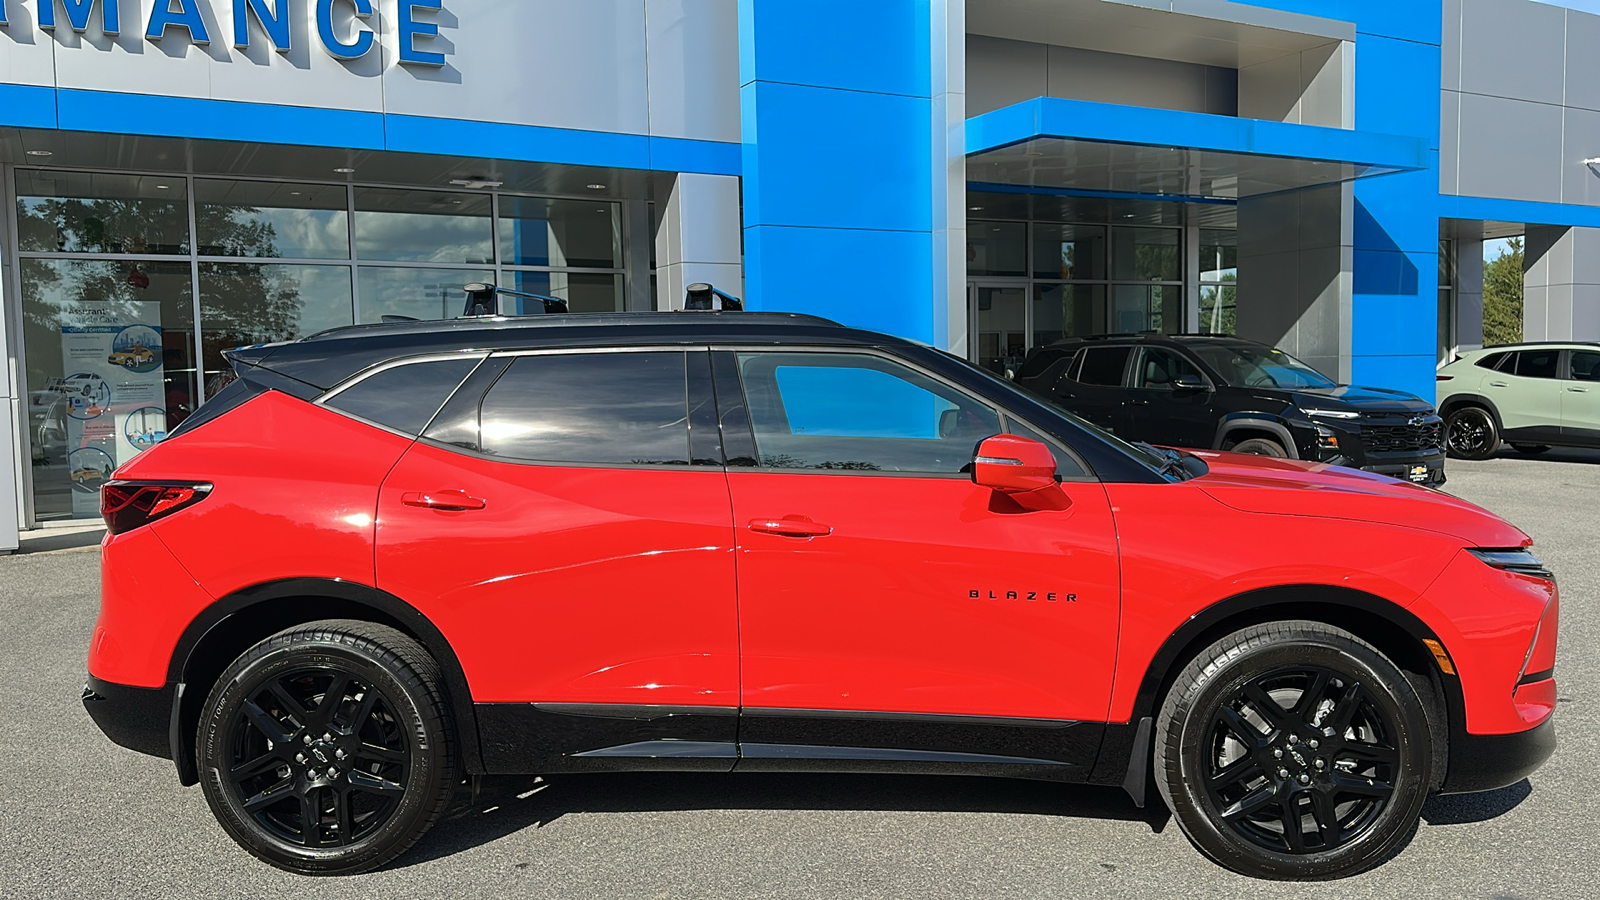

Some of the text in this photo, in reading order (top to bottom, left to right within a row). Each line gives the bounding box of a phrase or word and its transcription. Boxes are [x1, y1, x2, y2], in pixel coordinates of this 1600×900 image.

[0, 0, 446, 67] ANCE
[969, 589, 1078, 602] BLAZER
[213, 697, 227, 720] TOUR
